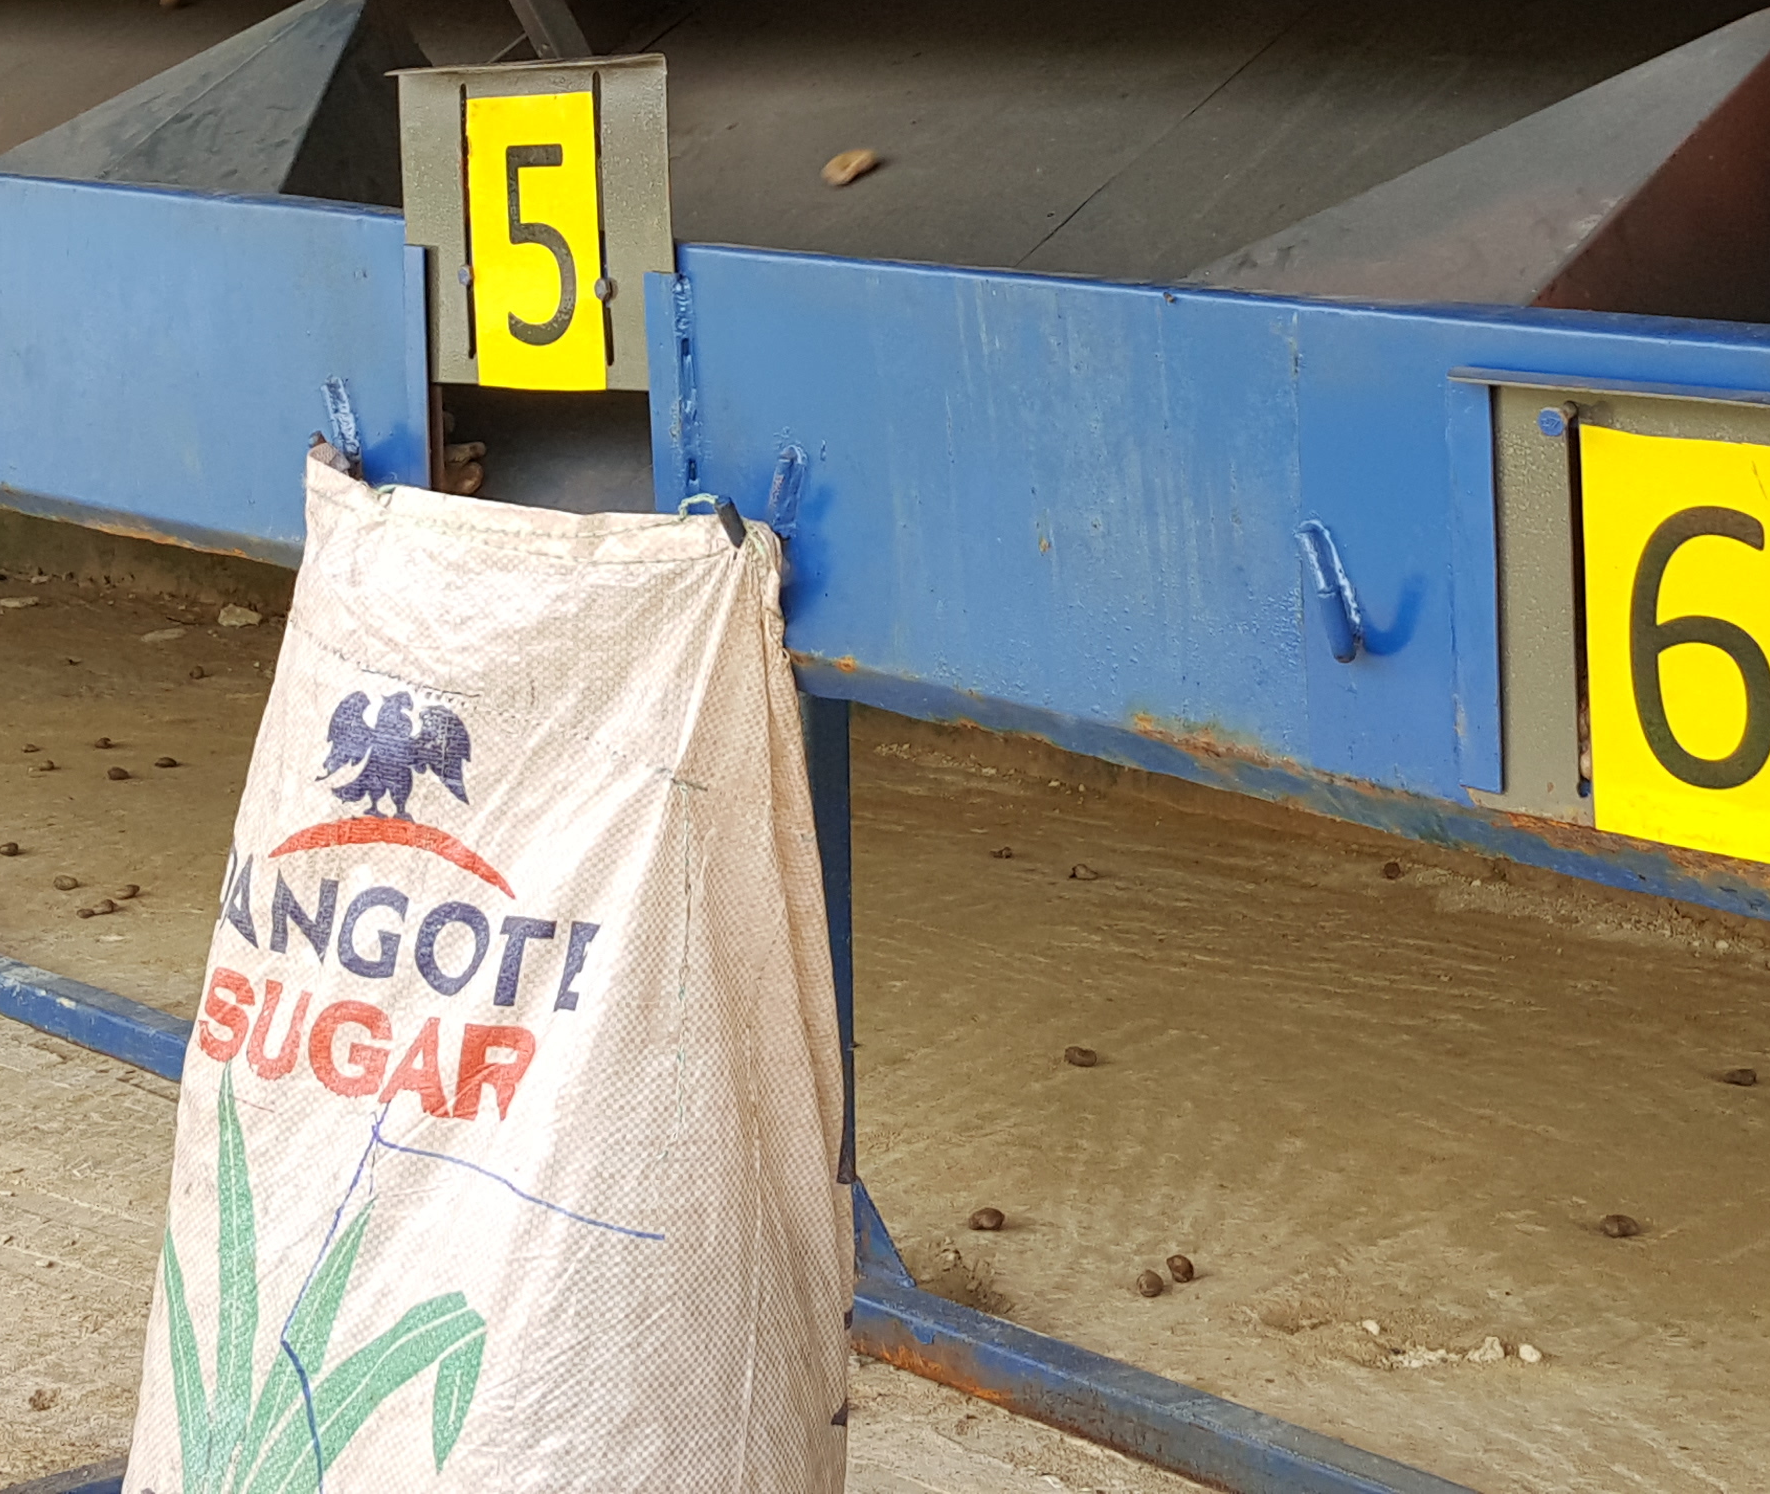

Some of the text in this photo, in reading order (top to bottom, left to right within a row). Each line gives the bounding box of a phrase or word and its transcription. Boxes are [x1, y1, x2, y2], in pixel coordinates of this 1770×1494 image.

[506, 143, 577, 346] 5
[220, 844, 600, 1013] ANGOTE
[199, 966, 536, 1122] SUGAR
